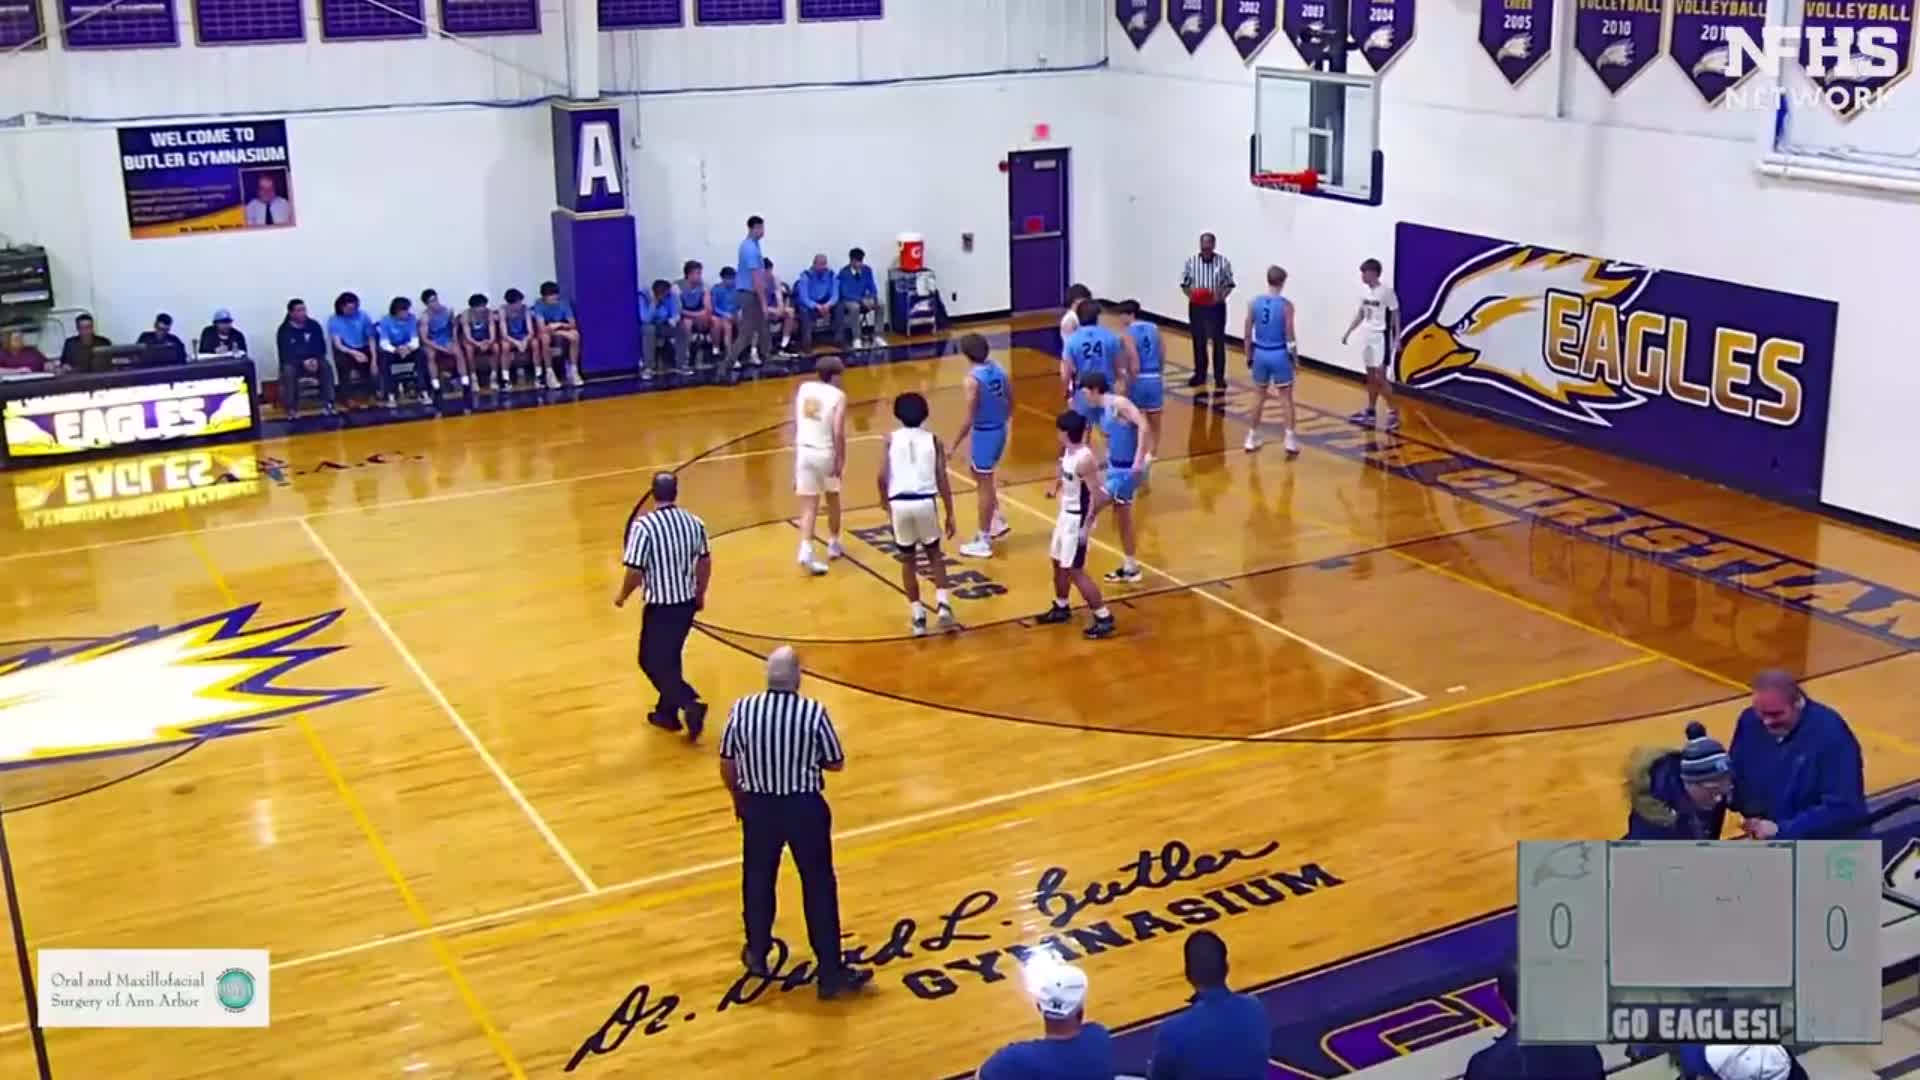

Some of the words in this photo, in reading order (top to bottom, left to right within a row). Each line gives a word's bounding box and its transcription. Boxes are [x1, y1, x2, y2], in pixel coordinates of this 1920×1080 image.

[1675, 0, 1767, 17] VOLLEYBALL
[1806, 2, 1910, 21] VOLLEYBALL
[1504, 15, 1532, 29] 2005
[1602, 20, 1631, 35] 2010
[151, 131, 231, 147] WELCOME
[234, 127, 254, 141] TO
[123, 153, 185, 170] BUTLER
[187, 146, 285, 166] GYMNASIUM
[580, 121, 620, 195] A
[1261, 307, 1271, 325] 3
[1082, 340, 1103, 359] 24
[1544, 291, 1805, 427] EAGLES
[54, 397, 207, 449] EAGLES
[563, 984, 696, 1073] Dr.
[920, 890, 1012, 952] L.
[1031, 840, 1280, 928] Butler
